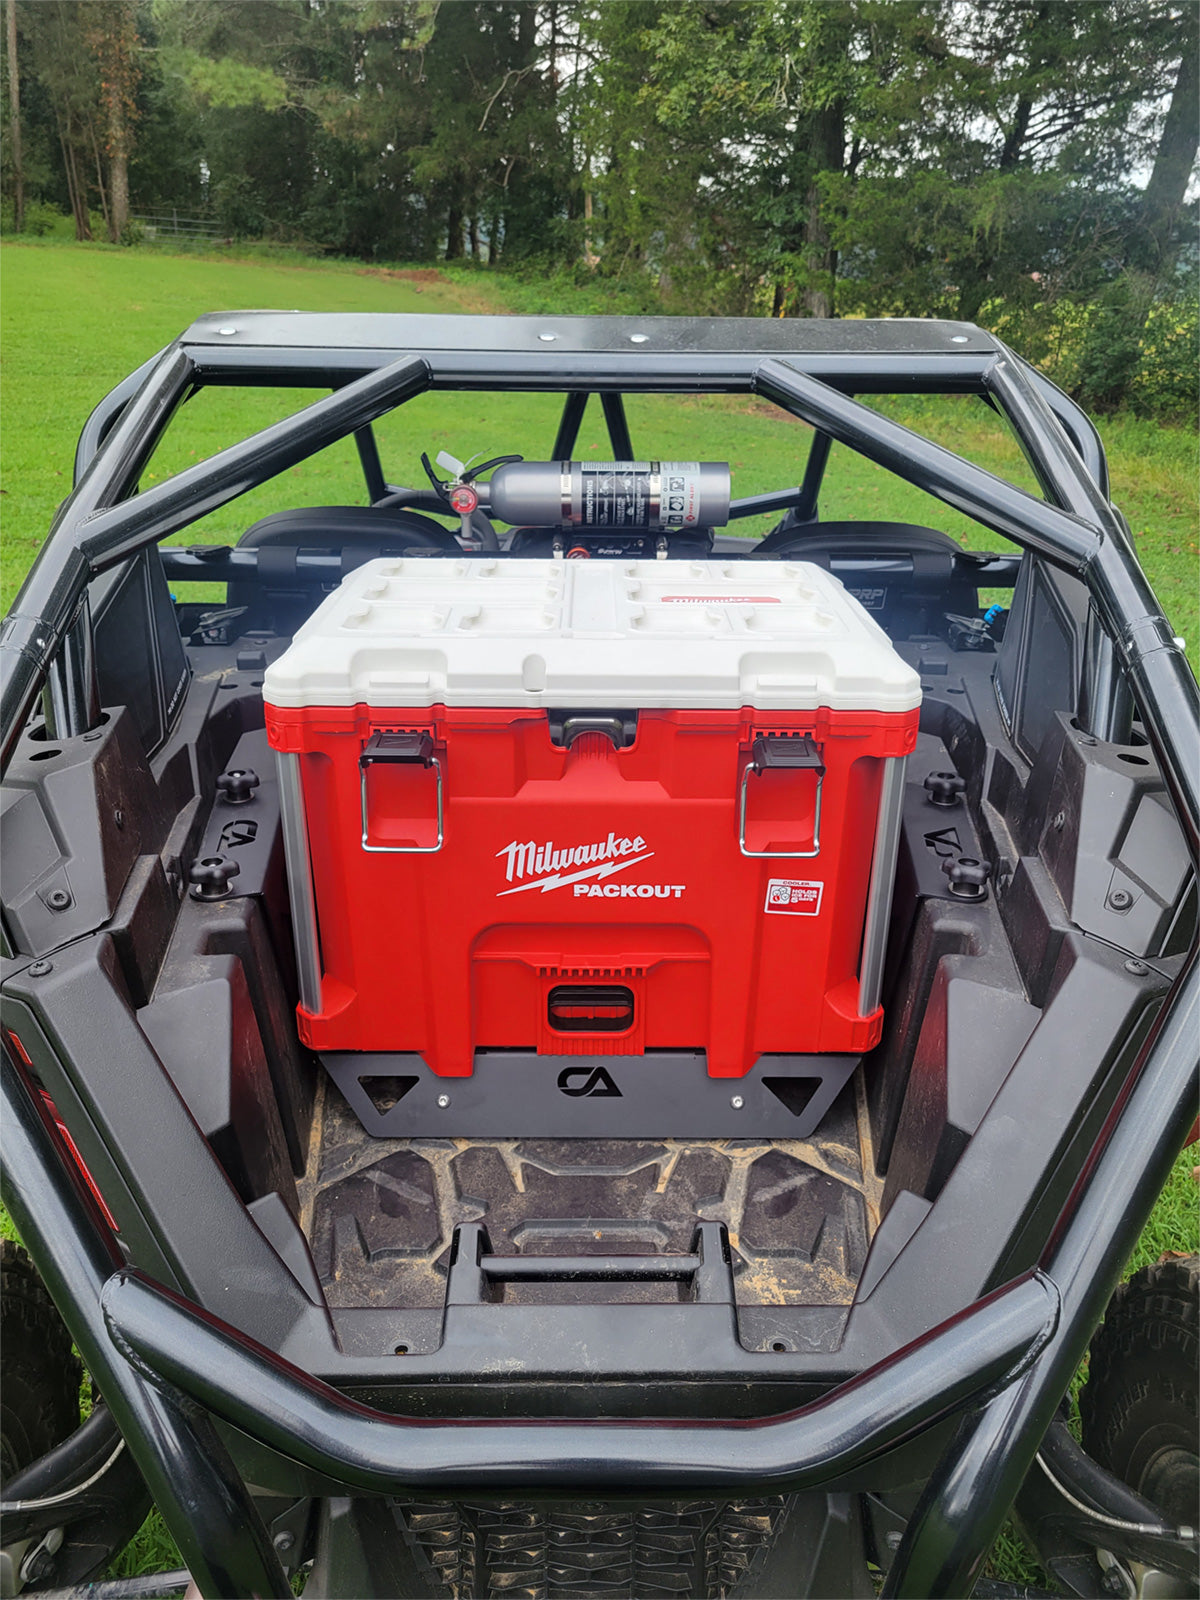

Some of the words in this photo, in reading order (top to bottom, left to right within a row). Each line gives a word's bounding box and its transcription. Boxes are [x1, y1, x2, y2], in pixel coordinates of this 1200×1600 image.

[848, 588, 884, 600] PRP
[496, 832, 648, 882] Milwaukee
[573, 883, 687, 898] PACKOUT
